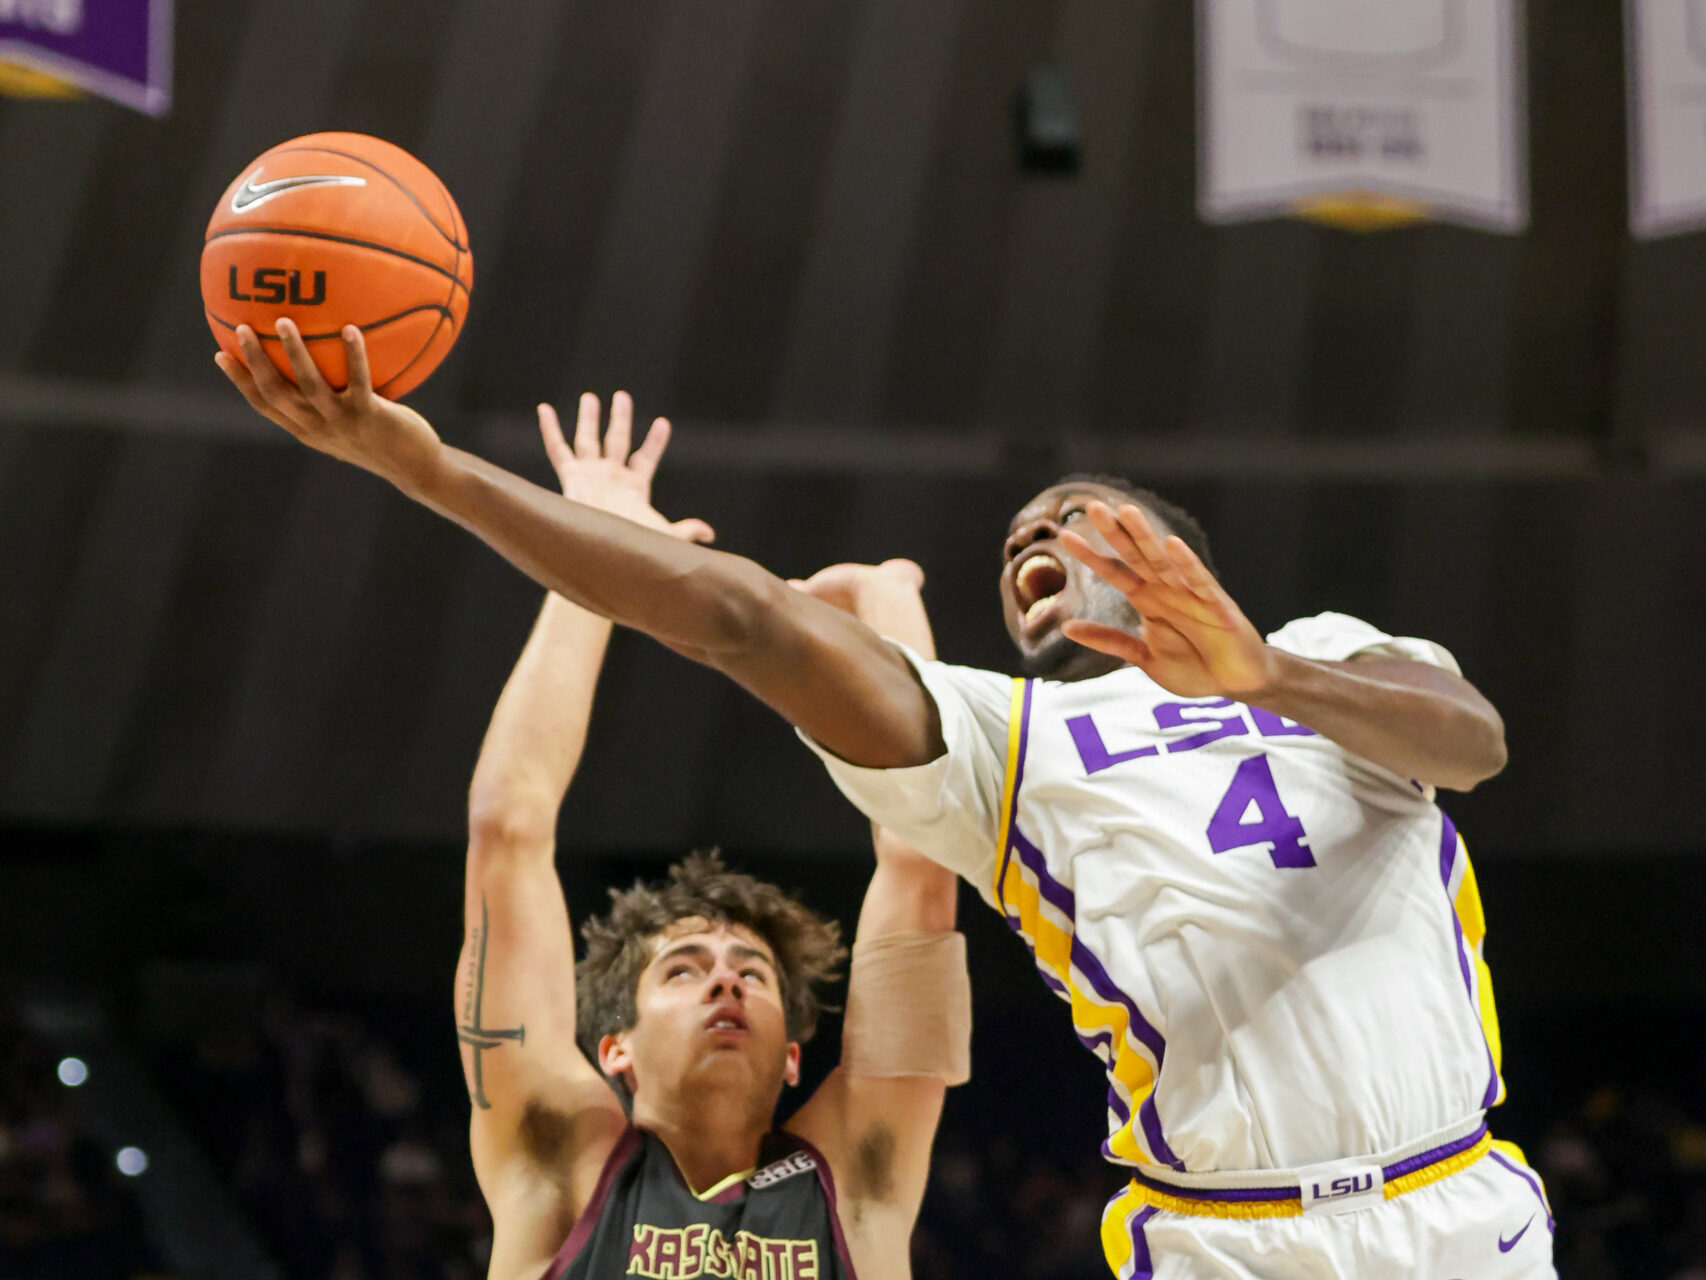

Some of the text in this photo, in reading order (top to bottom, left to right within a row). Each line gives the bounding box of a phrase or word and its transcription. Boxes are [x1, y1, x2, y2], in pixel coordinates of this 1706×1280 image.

[229, 265, 327, 306] LSU
[1206, 752, 1317, 869] 4
[1312, 1173, 1373, 1200] LSU
